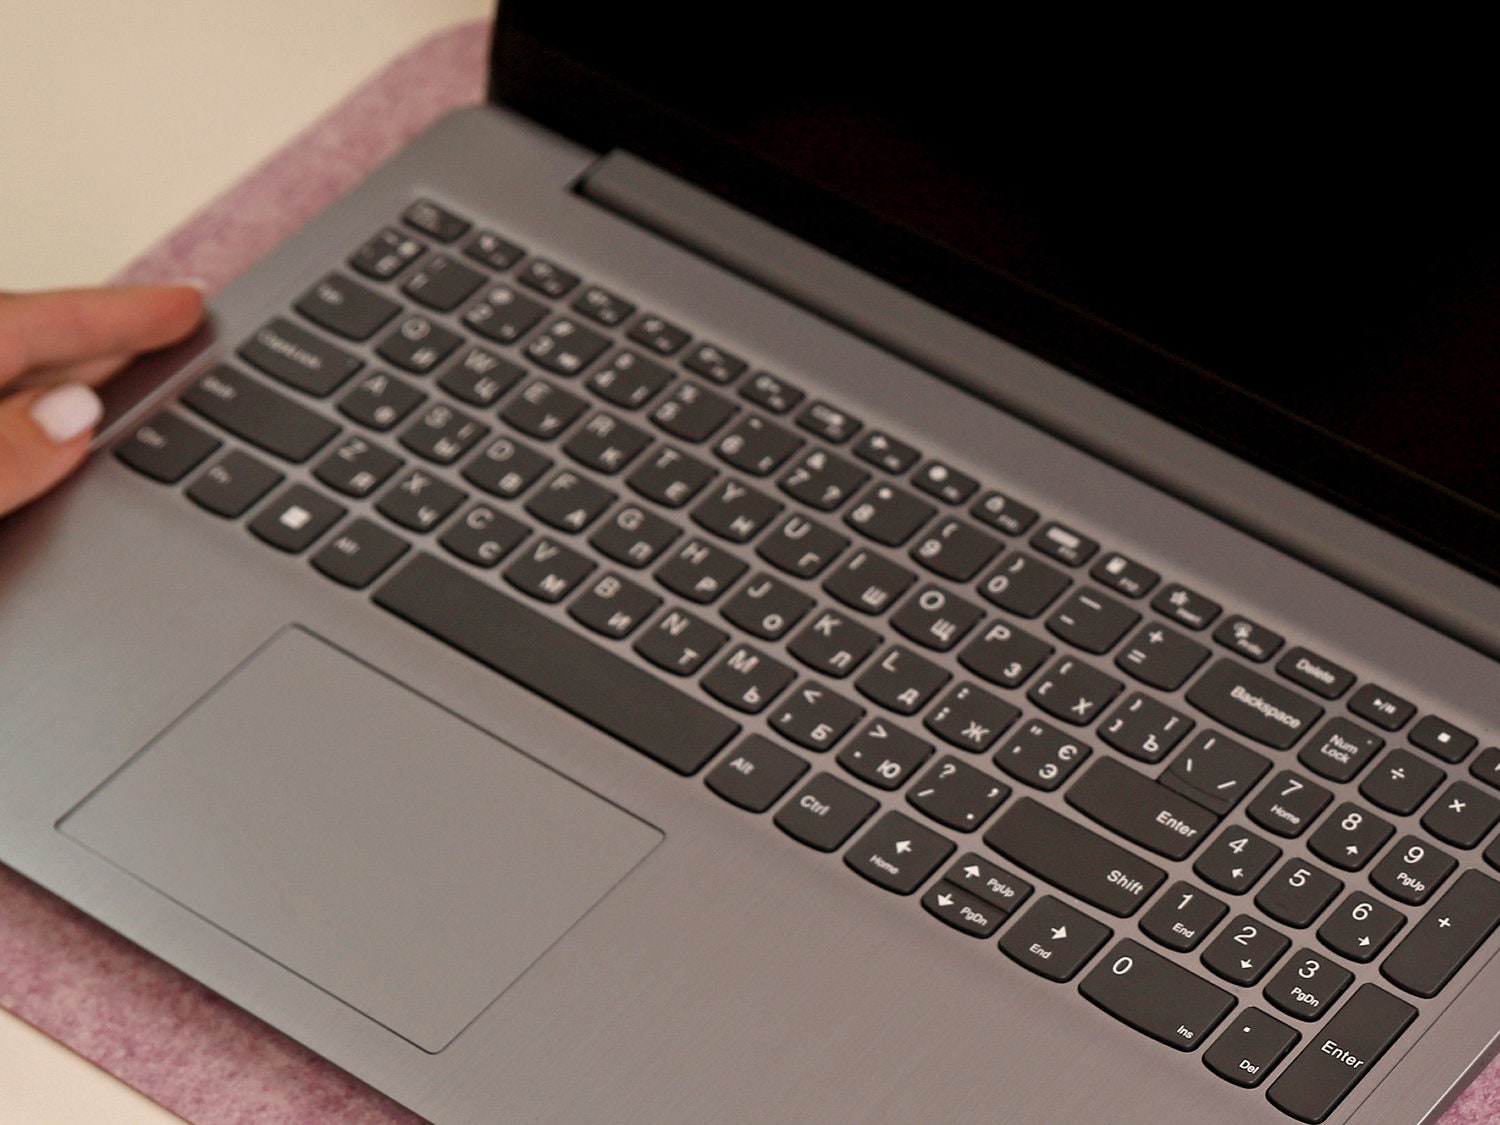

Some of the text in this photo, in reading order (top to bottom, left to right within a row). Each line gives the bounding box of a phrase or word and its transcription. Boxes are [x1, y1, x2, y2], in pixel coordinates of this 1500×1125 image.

[402, 472, 431, 495] X
[722, 483, 744, 501] Y
[467, 508, 493, 529] C
[852, 504, 874, 522] 8
[784, 518, 810, 538] U
[534, 542, 557, 561] V
[681, 542, 708, 563] H
[920, 540, 941, 557] 9
[594, 577, 621, 598] B
[748, 582, 771, 598] J
[988, 576, 1008, 593] 0
[919, 591, 945, 610] O
[661, 613, 688, 635] N
[814, 615, 840, 635] K
[985, 625, 1010, 640] P
[728, 650, 759, 672] M
[882, 651, 899, 671] L
[1296, 659, 1335, 683] Delete
[1231, 686, 1301, 728] Backspace
[811, 724, 833, 740] Б
[962, 722, 989, 742] Ж
[1329, 734, 1358, 754] Num
[1321, 745, 1350, 764] Lock
[730, 758, 754, 774] Alt
[877, 760, 901, 778] Ю
[1281, 780, 1303, 795] 7
[800, 795, 830, 815] Ctrl
[1271, 805, 1300, 824] Home
[1156, 811, 1196, 837] Enter
[1342, 813, 1362, 830] 8
[1229, 839, 1248, 853] 4
[1404, 847, 1424, 863] 9
[870, 855, 899, 874] Home
[1107, 870, 1143, 894] Shift
[1289, 869, 1311, 886] 5
[1397, 872, 1425, 891] PgUp
[987, 878, 1014, 897] PgUp
[1178, 895, 1193, 909] 1
[1352, 903, 1372, 920] 6
[960, 907, 987, 926] PgDn
[1172, 923, 1195, 938] End
[1234, 927, 1256, 945] 2
[1029, 944, 1051, 958] End
[1113, 957, 1132, 974] 0
[1299, 961, 1319, 978] 3
[1291, 987, 1319, 1007] PgDn
[1177, 1026, 1193, 1038] Ins
[1322, 1041, 1363, 1068] Enter
[1239, 1060, 1259, 1074] Del
